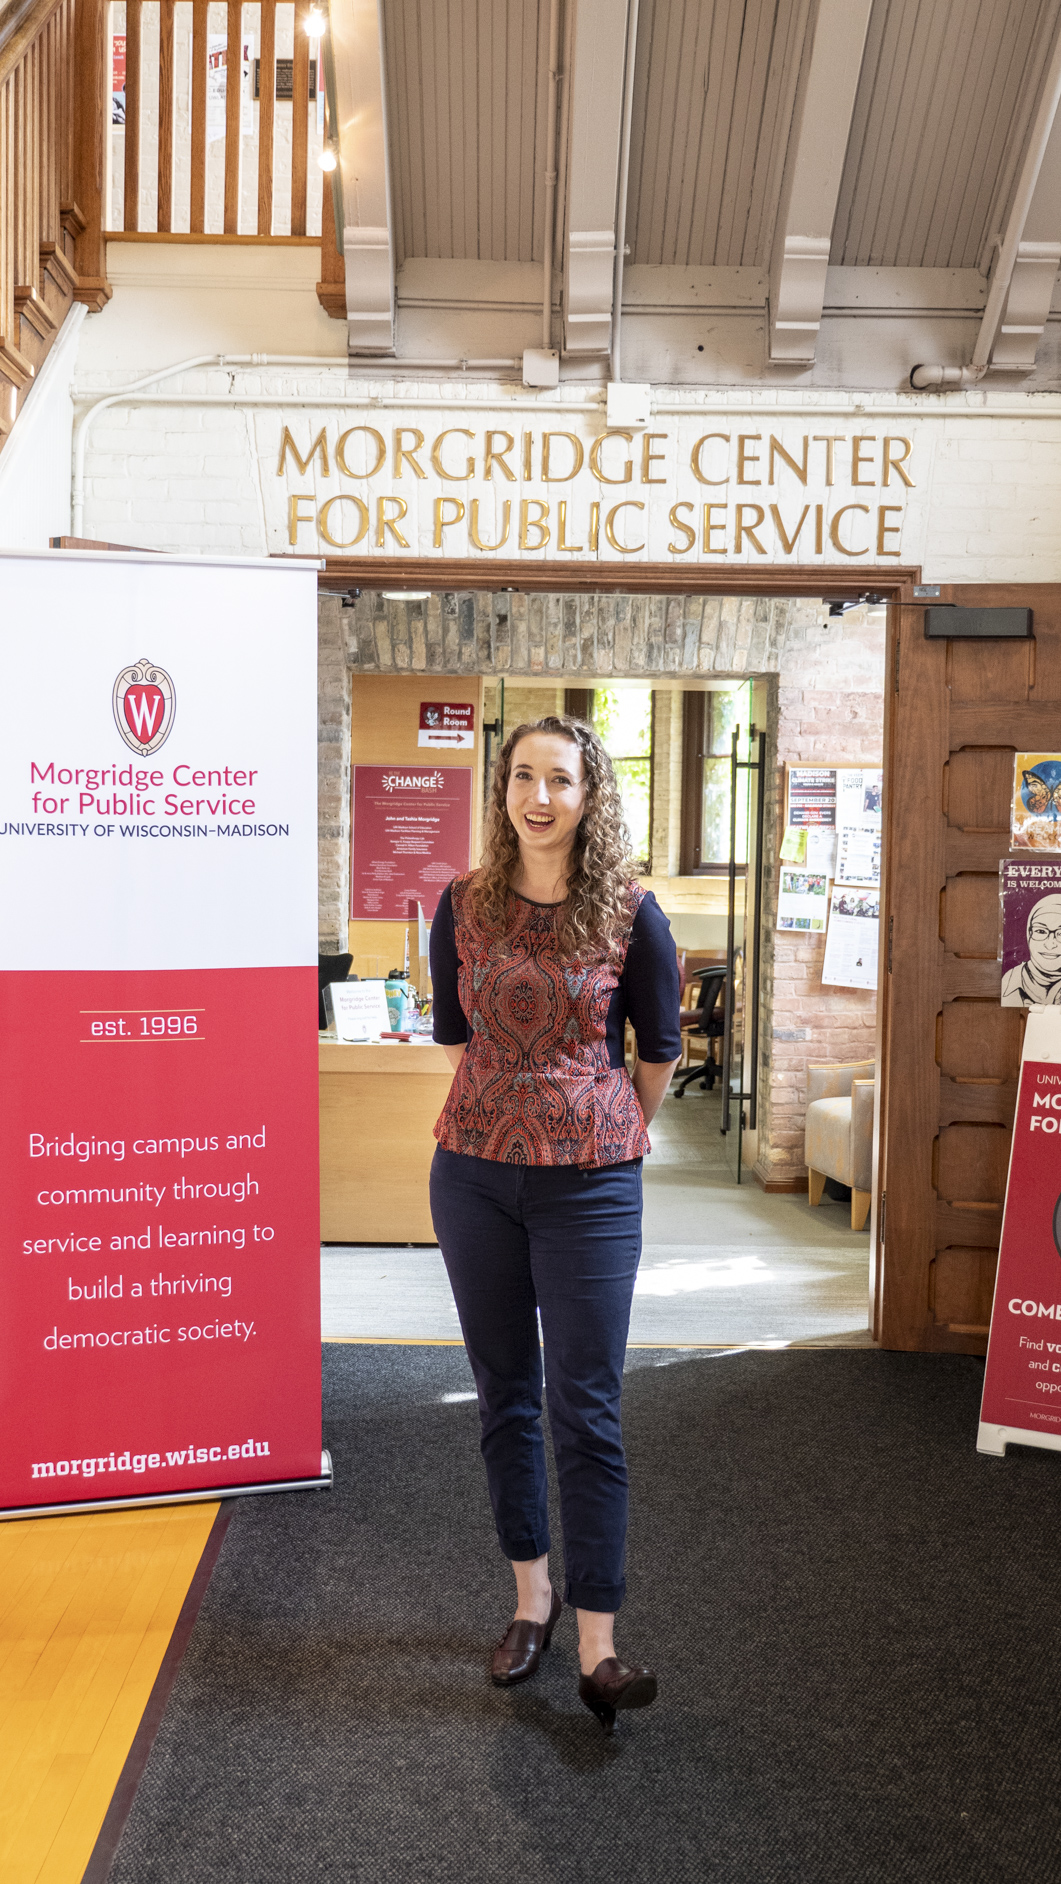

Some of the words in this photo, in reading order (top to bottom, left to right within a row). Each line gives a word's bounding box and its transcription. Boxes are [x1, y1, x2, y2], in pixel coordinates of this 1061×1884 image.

[277, 425, 667, 484] MORGRIDGE
[690, 432, 916, 488] CENTER
[289, 494, 410, 548] FOR
[434, 497, 645, 553] PUBLIC
[668, 501, 902, 557] SERVICE
[127, 691, 161, 736] W
[444, 706, 471, 716] Round
[444, 717, 468, 726] Room
[31, 761, 164, 791] Morgridge
[173, 764, 258, 787] Center
[388, 776, 437, 788] CHANGE
[32, 791, 70, 814] for
[80, 792, 156, 816] Public
[164, 793, 255, 816] Service
[94, 824, 116, 836] OF
[91, 1018, 131, 1036] est.
[140, 1016, 198, 1036] 1996
[1030, 1115, 1061, 1134] FO
[29, 1132, 125, 1162] Bridging
[133, 1135, 219, 1158] campus
[226, 1125, 266, 1150] and
[38, 1181, 166, 1207] community
[173, 1172, 259, 1202] through
[23, 1232, 102, 1255] service
[110, 1225, 152, 1250] and
[160, 1225, 246, 1250] learning
[253, 1224, 275, 1242] to
[69, 1274, 123, 1300] build
[130, 1282, 142, 1298] a
[150, 1272, 232, 1298] thriving
[44, 1324, 171, 1350] democratic
[178, 1318, 258, 1342] society.
[1019, 1336, 1044, 1351] Find
[1028, 1359, 1050, 1371] and
[32, 1438, 271, 1479] morgridge.wisc.edu
